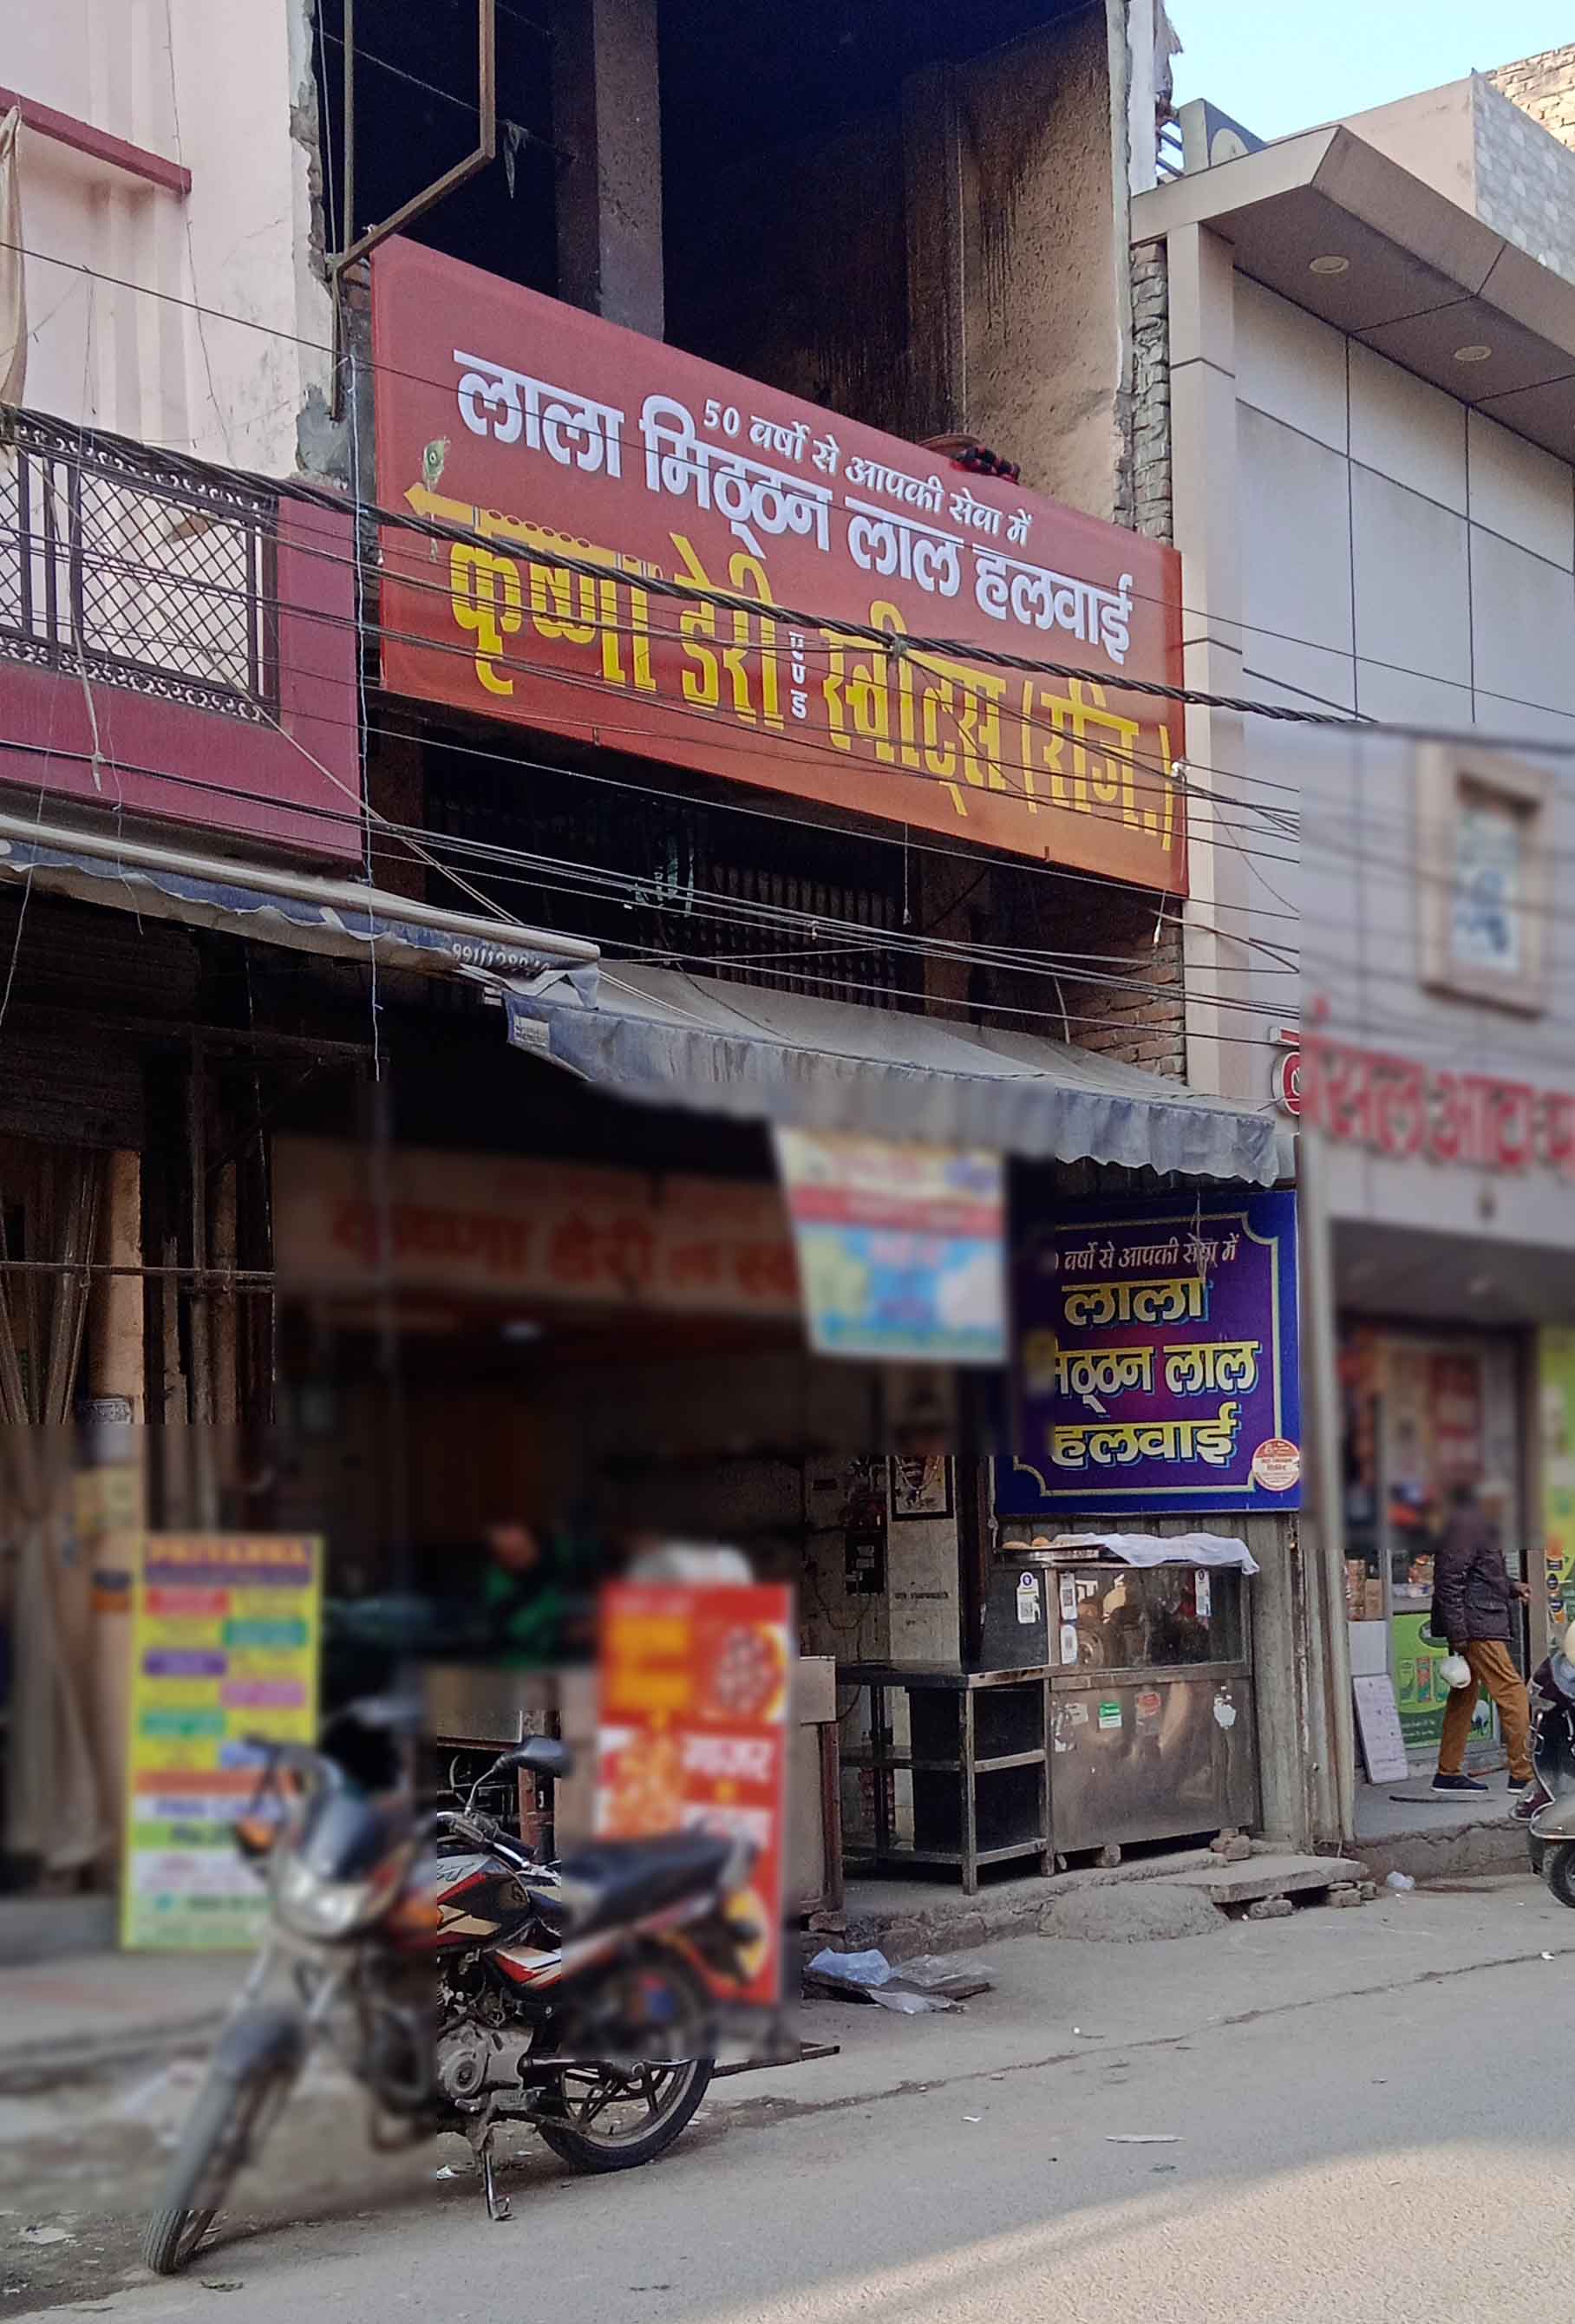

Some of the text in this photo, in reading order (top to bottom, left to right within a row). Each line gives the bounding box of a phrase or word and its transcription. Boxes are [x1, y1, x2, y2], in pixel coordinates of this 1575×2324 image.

[703, 399, 741, 436] 50
[812, 434, 840, 474] से
[845, 456, 944, 513] आपकी
[949, 486, 1003, 536] सेवा
[1006, 509, 1033, 547] में
[453, 349, 624, 478] लाला
[844, 496, 964, 597] लाल
[972, 573, 1134, 664] हलवाई
[669, 532, 784, 730] डेरी
[1099, 1240, 1115, 1270] से
[1119, 1237, 1180, 1268] आपकी
[1221, 1232, 1240, 1261] में
[1061, 1276, 1207, 1326] लाला
[1163, 1341, 1259, 1393] लाल
[1051, 1401, 1238, 1466] हलवाई
